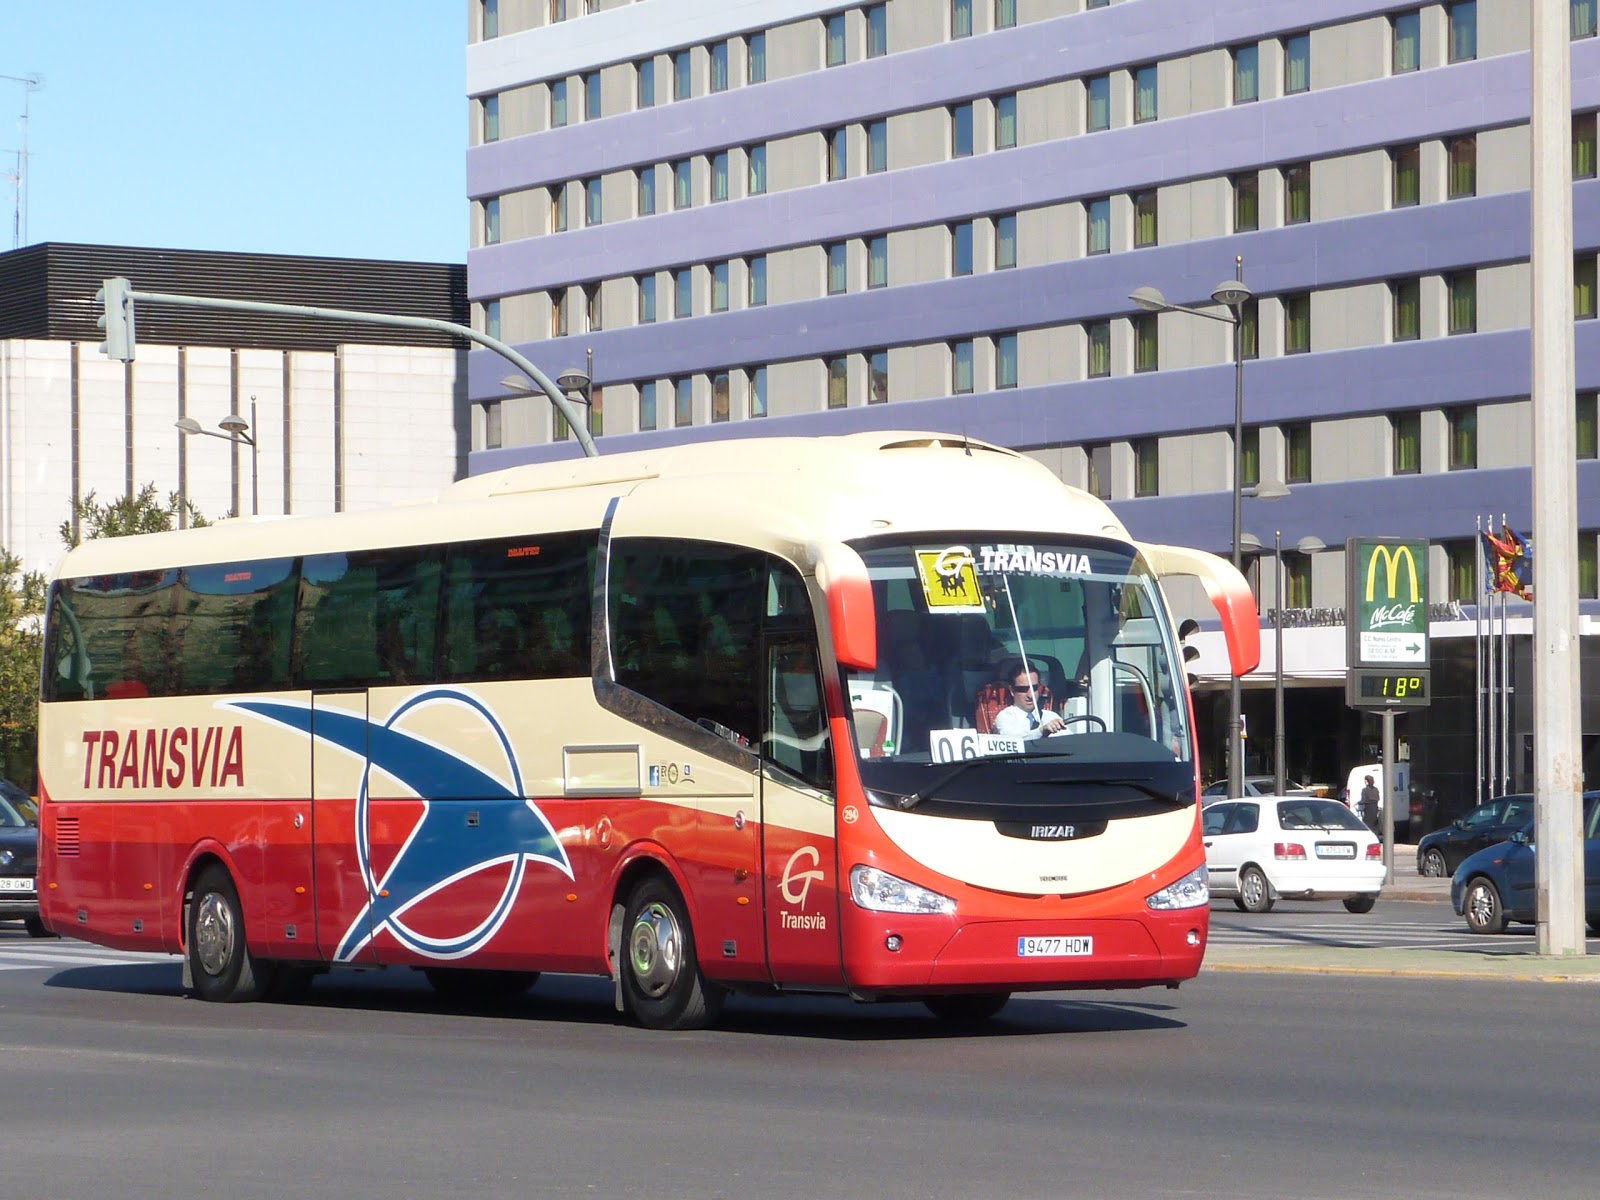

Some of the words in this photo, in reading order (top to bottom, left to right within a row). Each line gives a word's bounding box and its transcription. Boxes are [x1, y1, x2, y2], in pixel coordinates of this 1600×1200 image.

[980, 551, 1092, 575] TRANSVIA
[1370, 604, 1415, 627] McCafé
[938, 736, 977, 763] 06
[987, 740, 1018, 752] LYCEE
[82, 726, 244, 789] TRANSVIA
[1031, 826, 1075, 837] IRIZAR
[780, 911, 826, 930] Transvia
[1027, 939, 1061, 954] 9477
[1065, 939, 1090, 953] HDW
